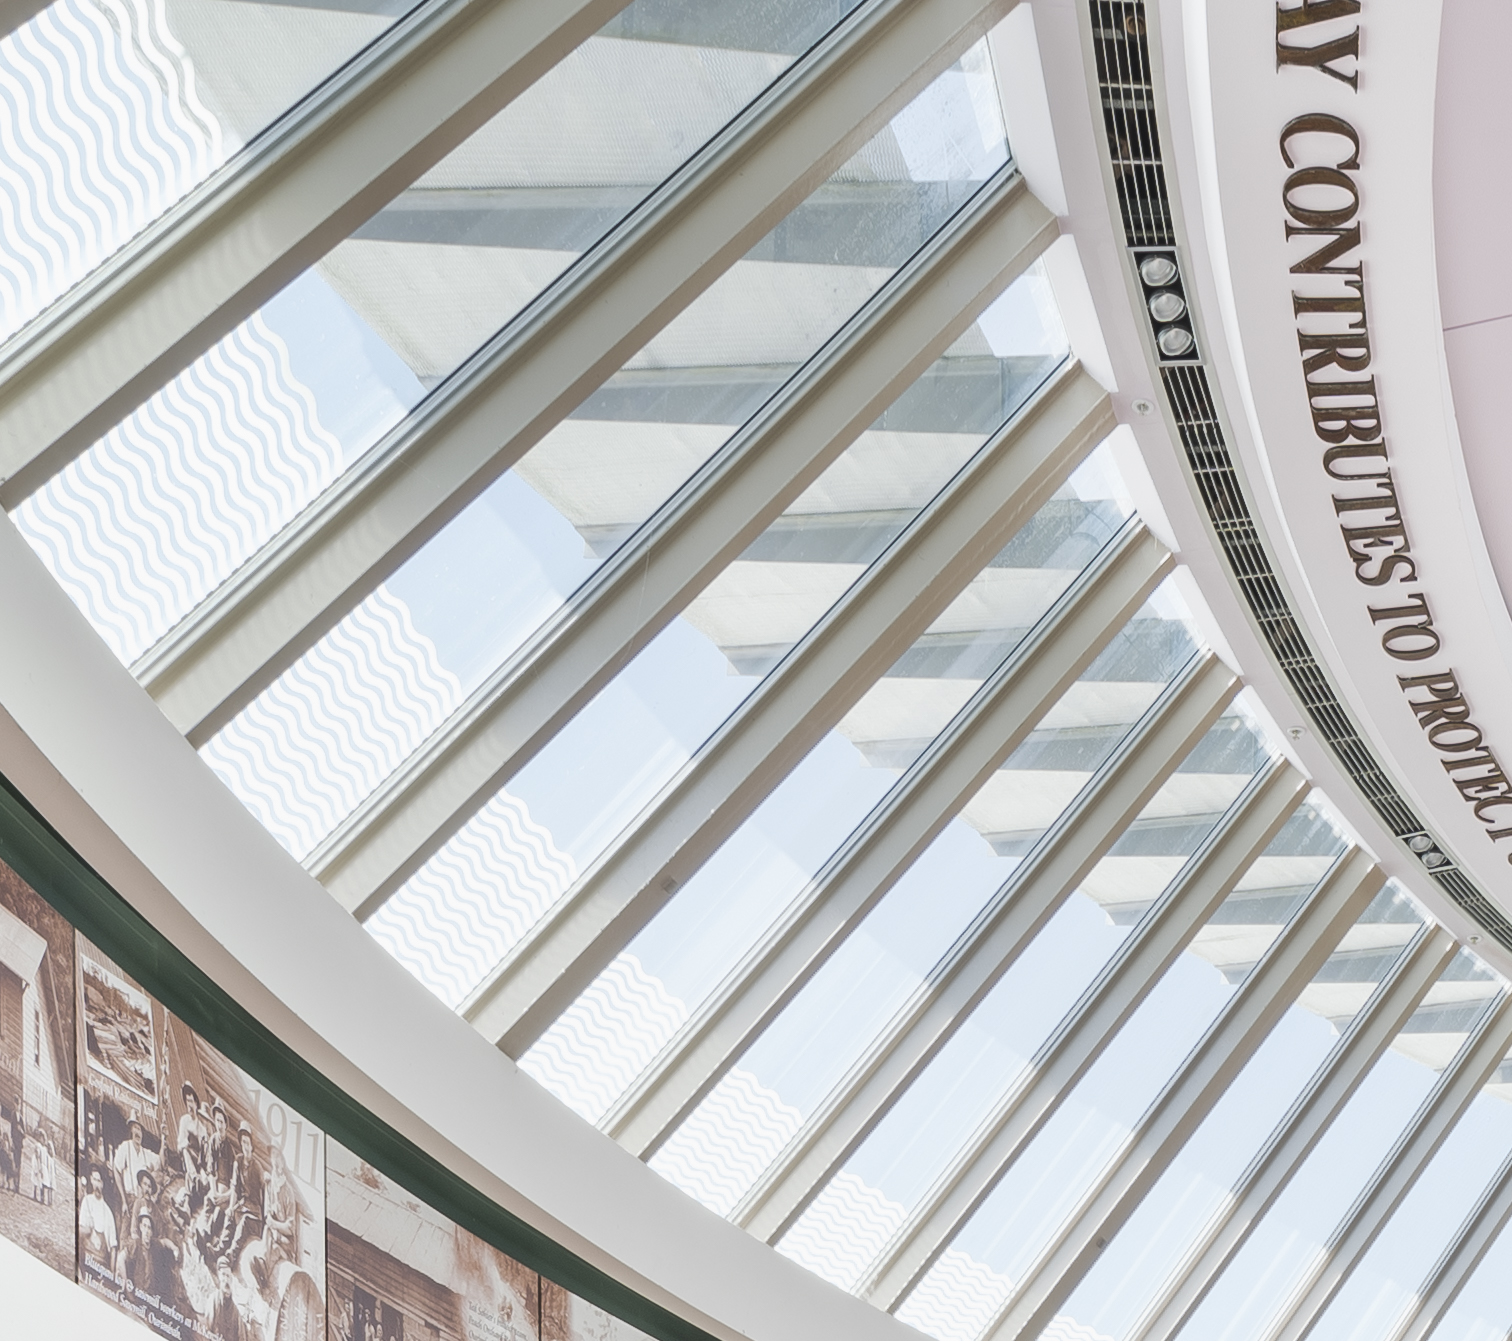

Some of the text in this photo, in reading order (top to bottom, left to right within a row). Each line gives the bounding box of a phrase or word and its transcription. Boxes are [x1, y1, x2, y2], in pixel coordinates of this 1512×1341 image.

[1278, 112, 1418, 588] CONTRIBUTES
[1367, 593, 1440, 661] TO
[248, 1089, 321, 1191] 1911
